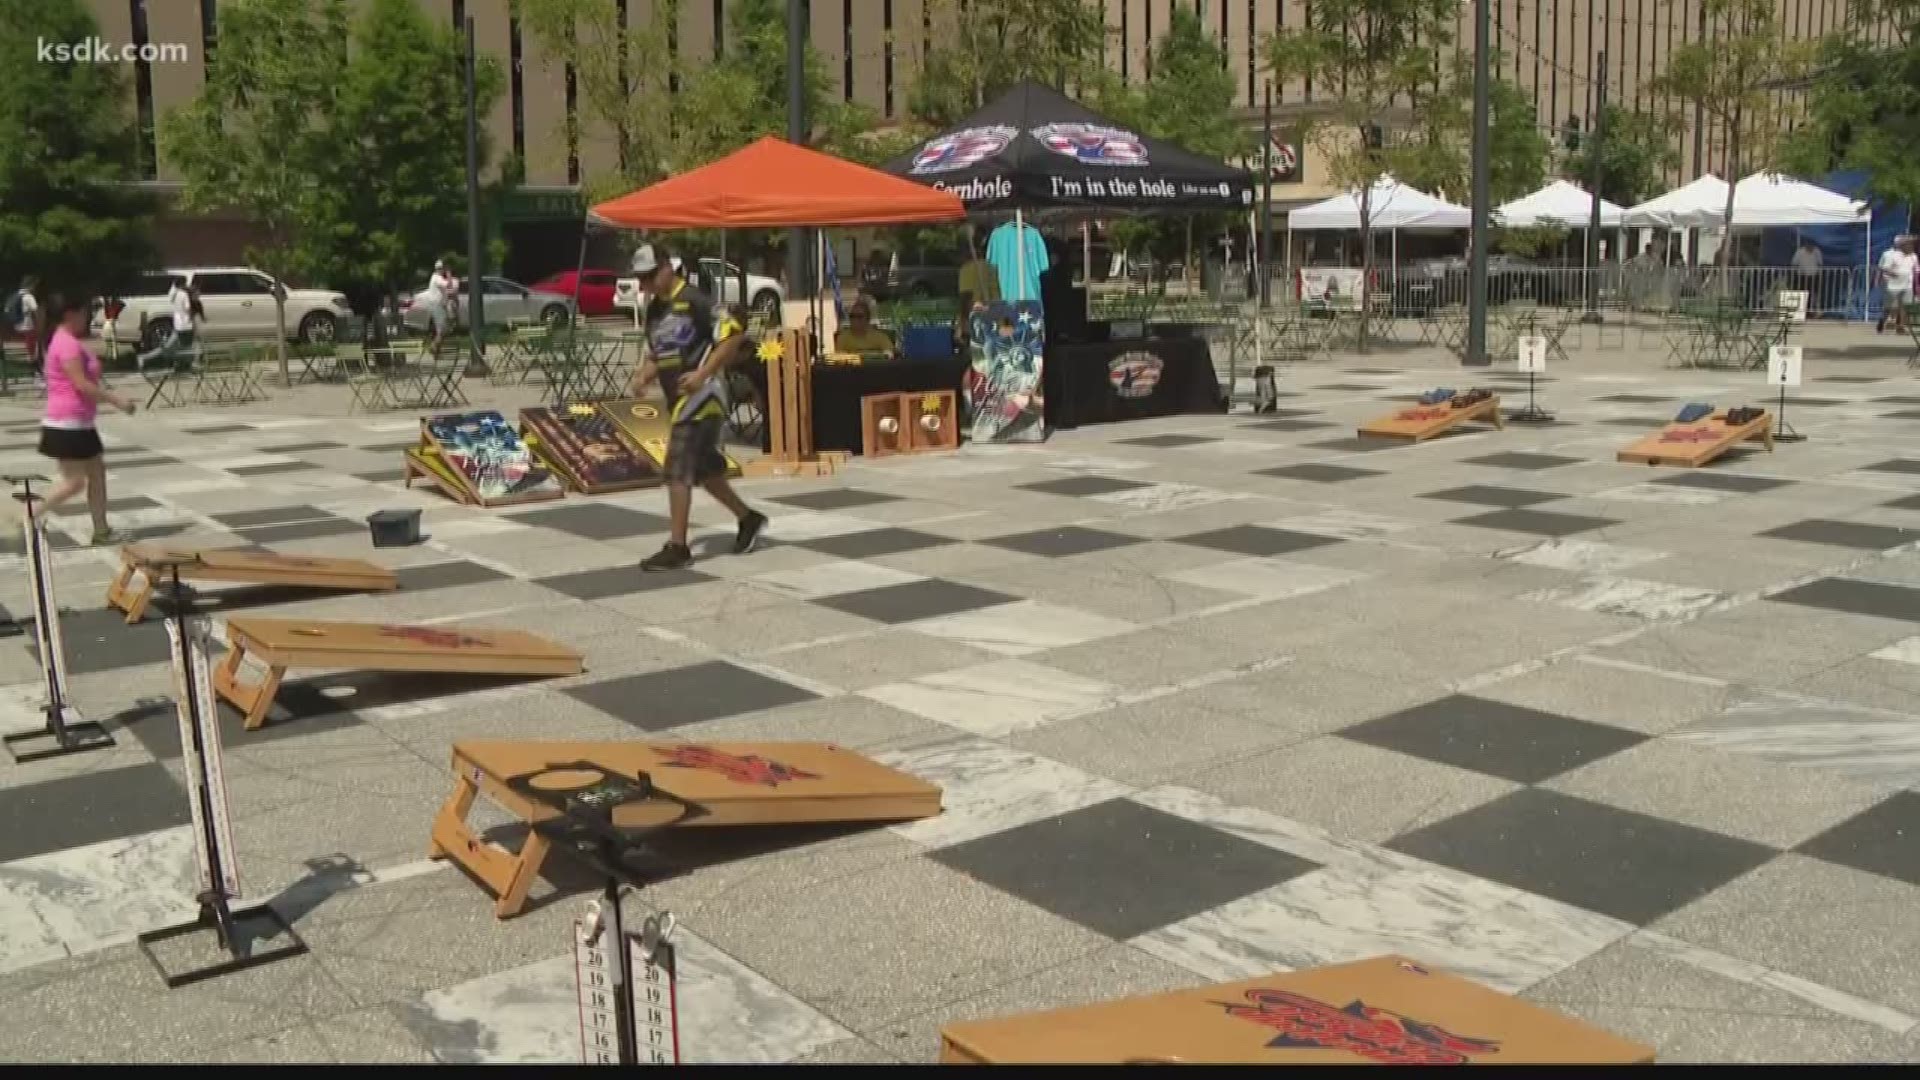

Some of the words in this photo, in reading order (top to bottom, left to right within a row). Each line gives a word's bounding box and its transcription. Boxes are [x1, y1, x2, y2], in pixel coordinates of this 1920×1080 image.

[1050, 176, 1082, 197] I'm
[1086, 176, 1105, 197] in
[1109, 176, 1137, 197] the
[1140, 177, 1176, 198] hole
[588, 949, 603, 967] 20
[590, 971, 604, 986] 19
[645, 964, 660, 982] 20
[592, 991, 606, 1008] 18
[647, 986, 661, 1003] 19
[594, 1011, 607, 1028] 17
[648, 1007, 662, 1024] 18
[595, 1031, 609, 1047] 16
[650, 1027, 663, 1044] 17
[651, 1048, 665, 1065] 16
